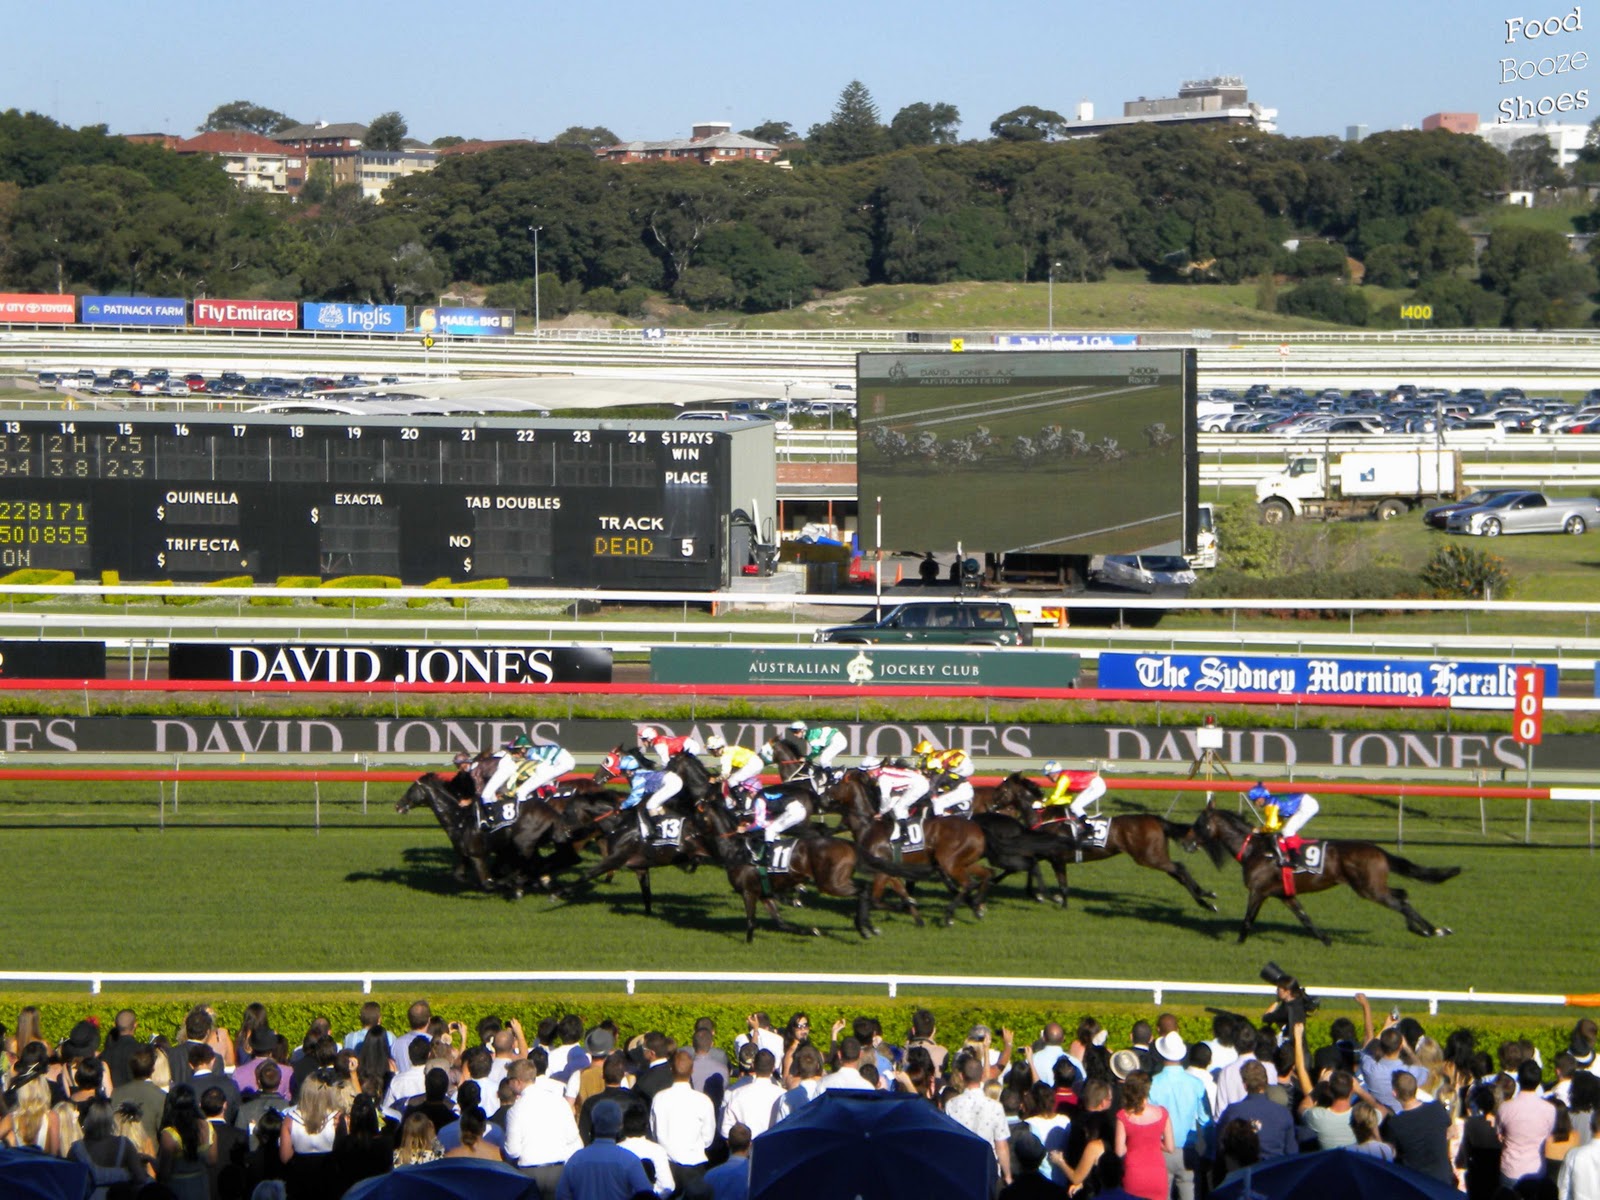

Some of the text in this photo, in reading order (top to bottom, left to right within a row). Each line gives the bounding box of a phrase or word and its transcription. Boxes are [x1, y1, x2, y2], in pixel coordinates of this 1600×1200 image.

[40, 303, 73, 313] TOYOTA
[103, 304, 184, 317] PATINACK FARM
[198, 304, 294, 323] Fly Emirates
[1400, 304, 1432, 320] 1400
[347, 306, 392, 331] Inglis
[440, 315, 475, 326] MAKE
[480, 316, 500, 327] BIG
[646, 328, 661, 338] 14
[5, 421, 646, 444] 13 14 15 16 17 18 19 20 21 22 23 24
[661, 431, 714, 446] $1 PAYS
[105, 436, 142, 454] 7.5
[671, 447, 700, 461] WIN
[107, 460, 145, 478] 2.3
[664, 471, 709, 485] PLACE
[165, 491, 239, 505] QUINELLA
[334, 493, 383, 506] EXACTA
[465, 496, 561, 510] TAB DOUBLES
[0, 502, 86, 520] 228171
[156, 504, 166, 521] $
[310, 506, 320, 524] $
[598, 516, 664, 531] TRACK
[0, 525, 88, 544] 500855
[449, 535, 472, 548] NO
[165, 538, 240, 552] TRIFECTA
[595, 537, 654, 556] DEAD
[680, 538, 694, 557] 5
[3, 549, 31, 567] ON
[156, 552, 166, 568] $
[463, 557, 473, 573] $
[230, 647, 554, 684] DAVID JONES
[749, 663, 980, 677] AUSTRALIAN JOCKEY CLUB
[1135, 656, 1518, 697] The Sydney Morning Herald
[152, 719, 561, 754] DAVID JONES
[848, 724, 1033, 758] JONES
[1105, 728, 1527, 769] DAVID JONES
[502, 803, 516, 820] 8
[661, 818, 680, 839] 13
[772, 845, 791, 868] 11
[1305, 845, 1321, 867] 9
